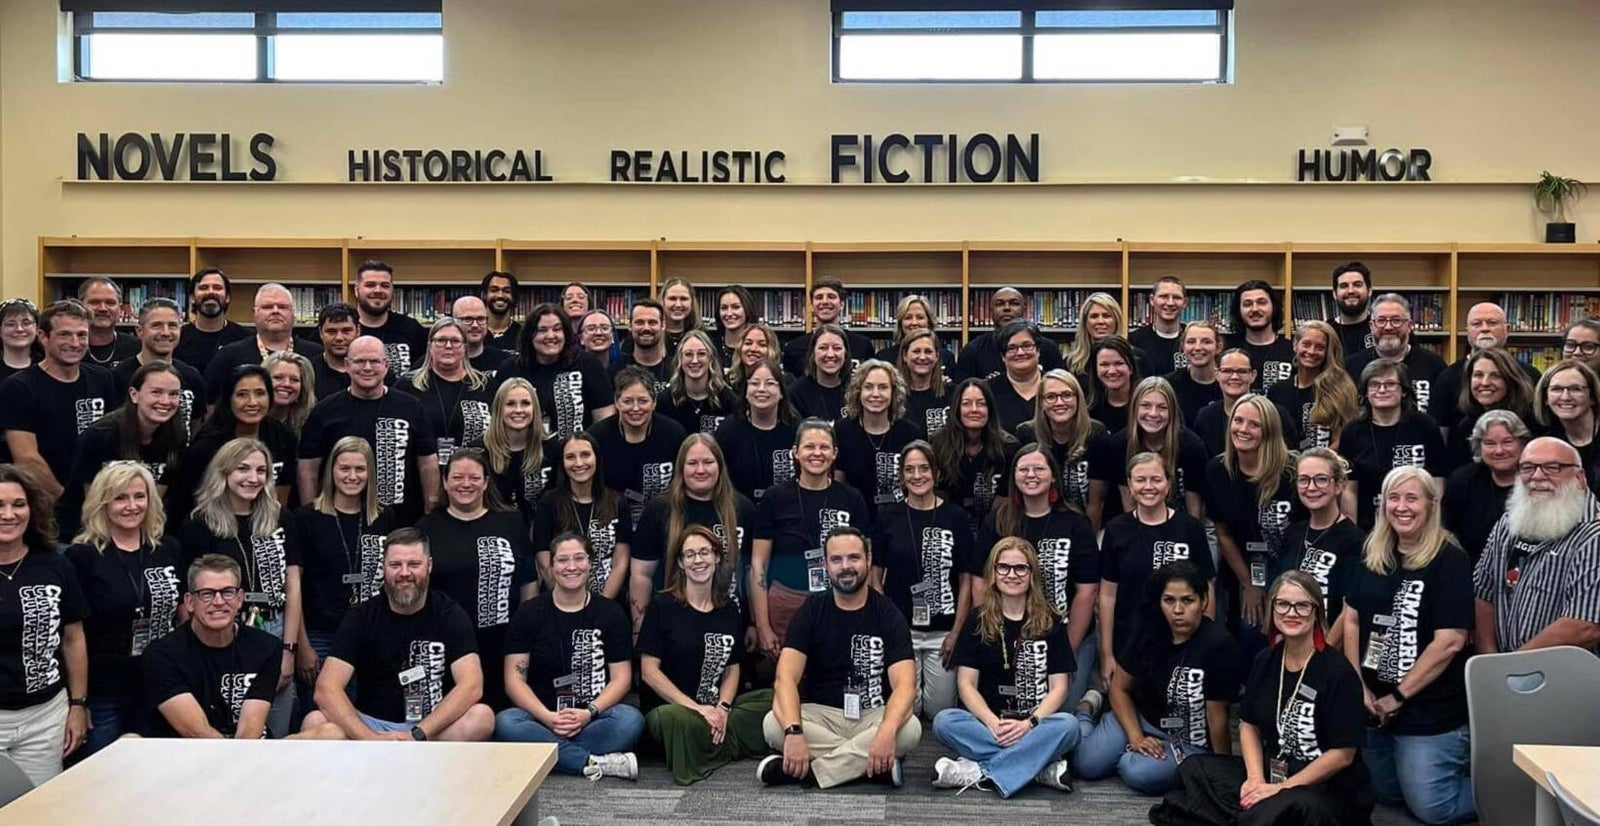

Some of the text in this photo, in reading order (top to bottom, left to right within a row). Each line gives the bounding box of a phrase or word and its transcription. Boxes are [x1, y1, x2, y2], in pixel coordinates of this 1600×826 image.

[76, 132, 277, 181] NOVELS
[347, 149, 553, 182] HISTORICAL
[609, 150, 787, 183] REALISTIC
[830, 133, 1040, 183] FICTION
[1297, 148, 1433, 182] HUMOR
[393, 417, 410, 504] CIMARRON
[496, 536, 515, 624] CIMARRON
[939, 528, 955, 615] CIMARRON
[1054, 537, 1071, 623] CIMARRO
